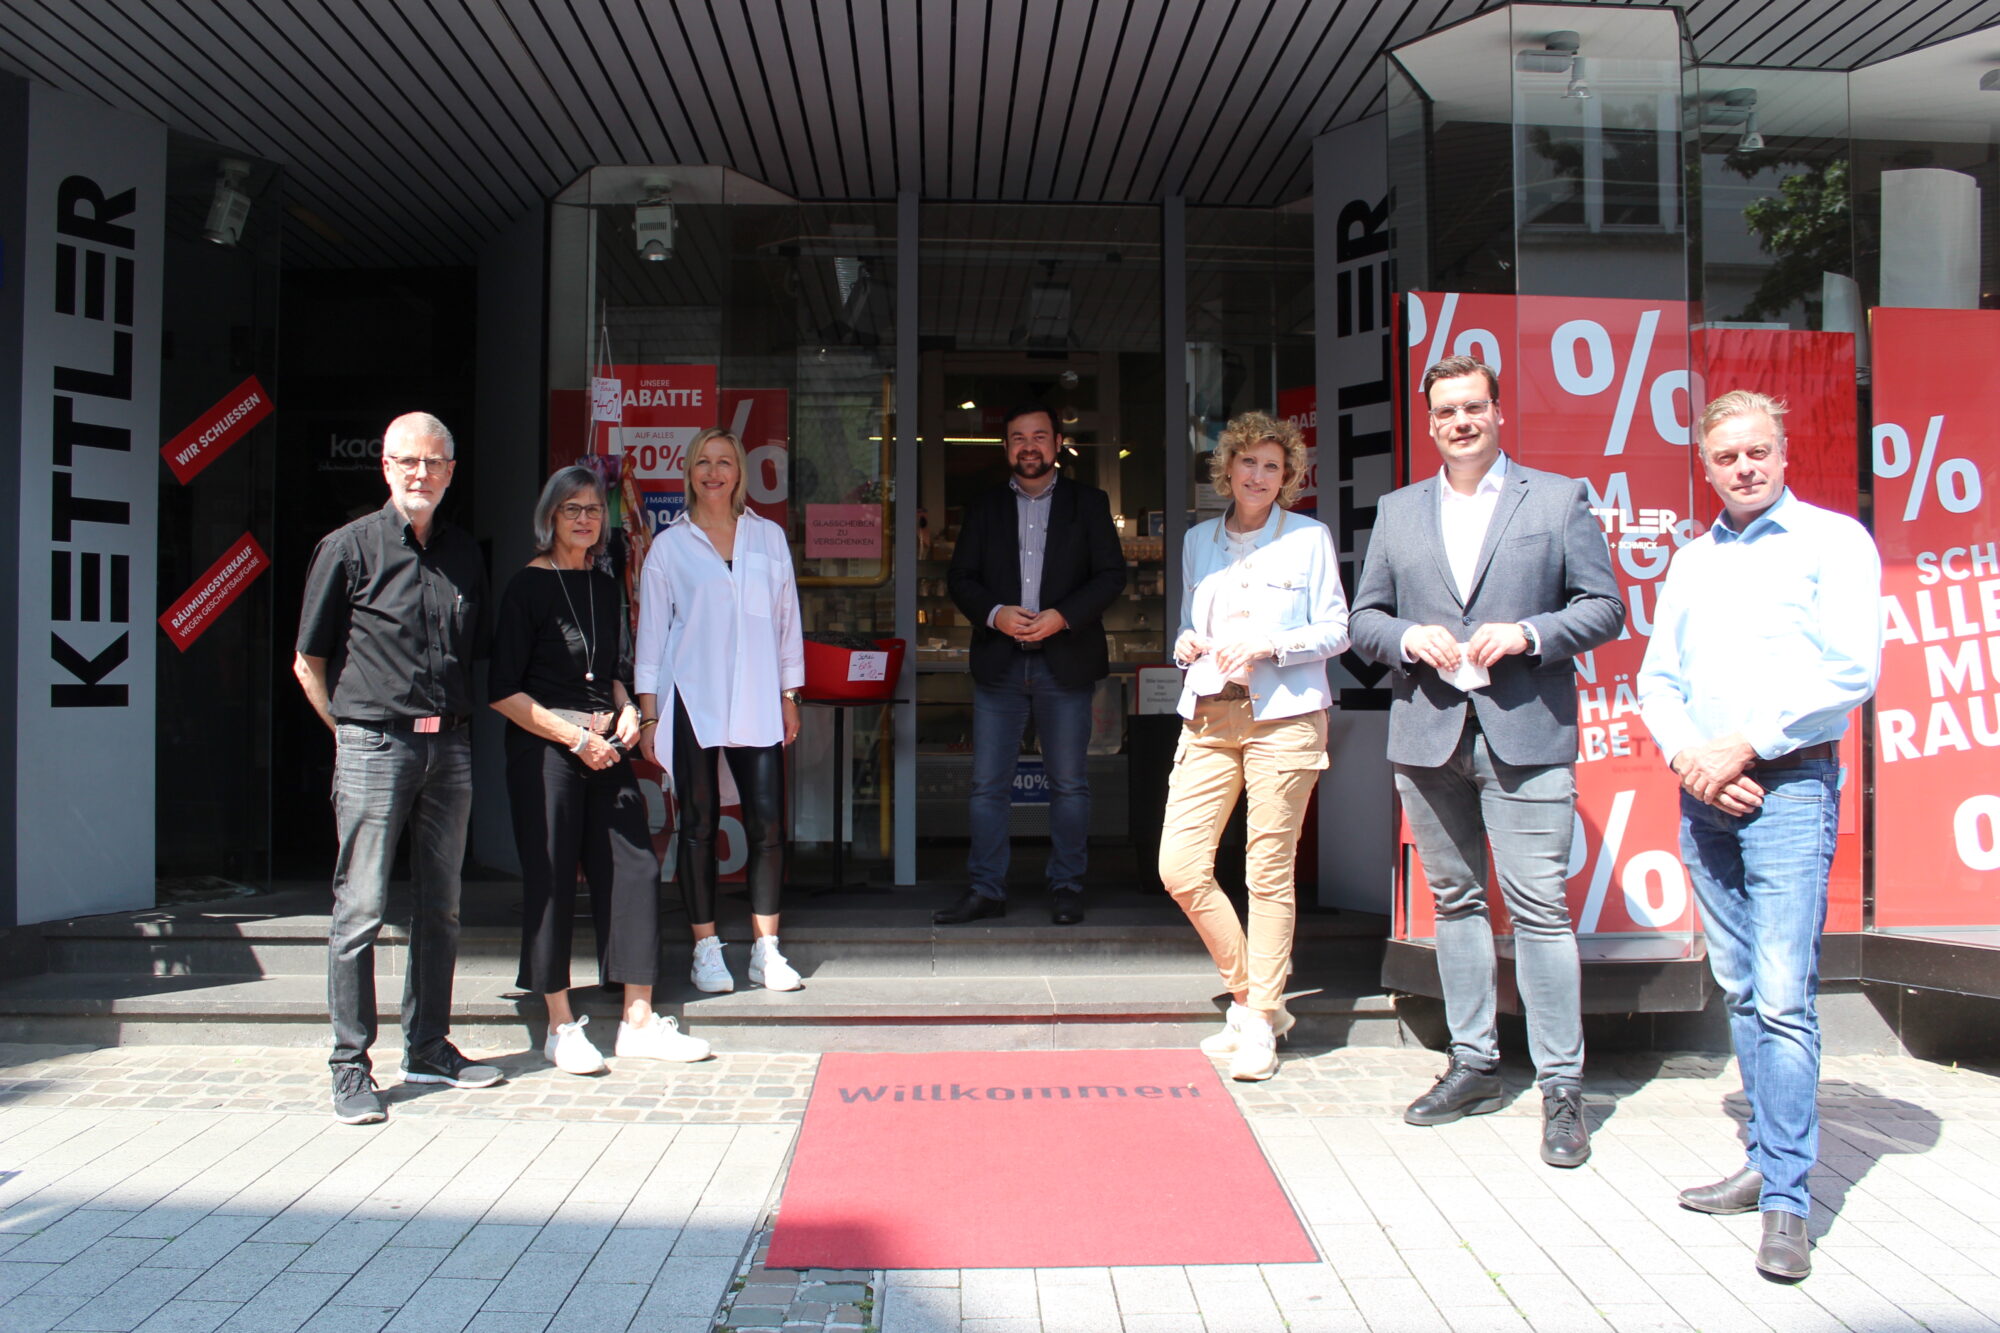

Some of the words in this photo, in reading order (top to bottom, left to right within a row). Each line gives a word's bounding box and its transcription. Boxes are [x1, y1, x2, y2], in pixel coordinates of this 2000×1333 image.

[640, 379, 670, 387] UNSERE
[622, 389, 703, 407] ABATTE
[51, 175, 136, 707] KETTLER
[175, 443, 201, 466] WIR
[199, 393, 261, 447] SCHLIESSEN
[624, 444, 685, 472] 30%
[812, 519, 875, 528] GLASSCHEIBEN
[1589, 508, 1678, 534] TLER
[1618, 541, 1658, 550] SCHMUCK
[171, 546, 253, 629] RÄUMUNGSVERKAUF
[179, 613, 204, 638] WEGEN
[201, 556, 260, 616] GESCHÄFTSAUFGABE
[1012, 774, 1050, 790] 40%
[838, 1084, 1202, 1104] Willkommen
